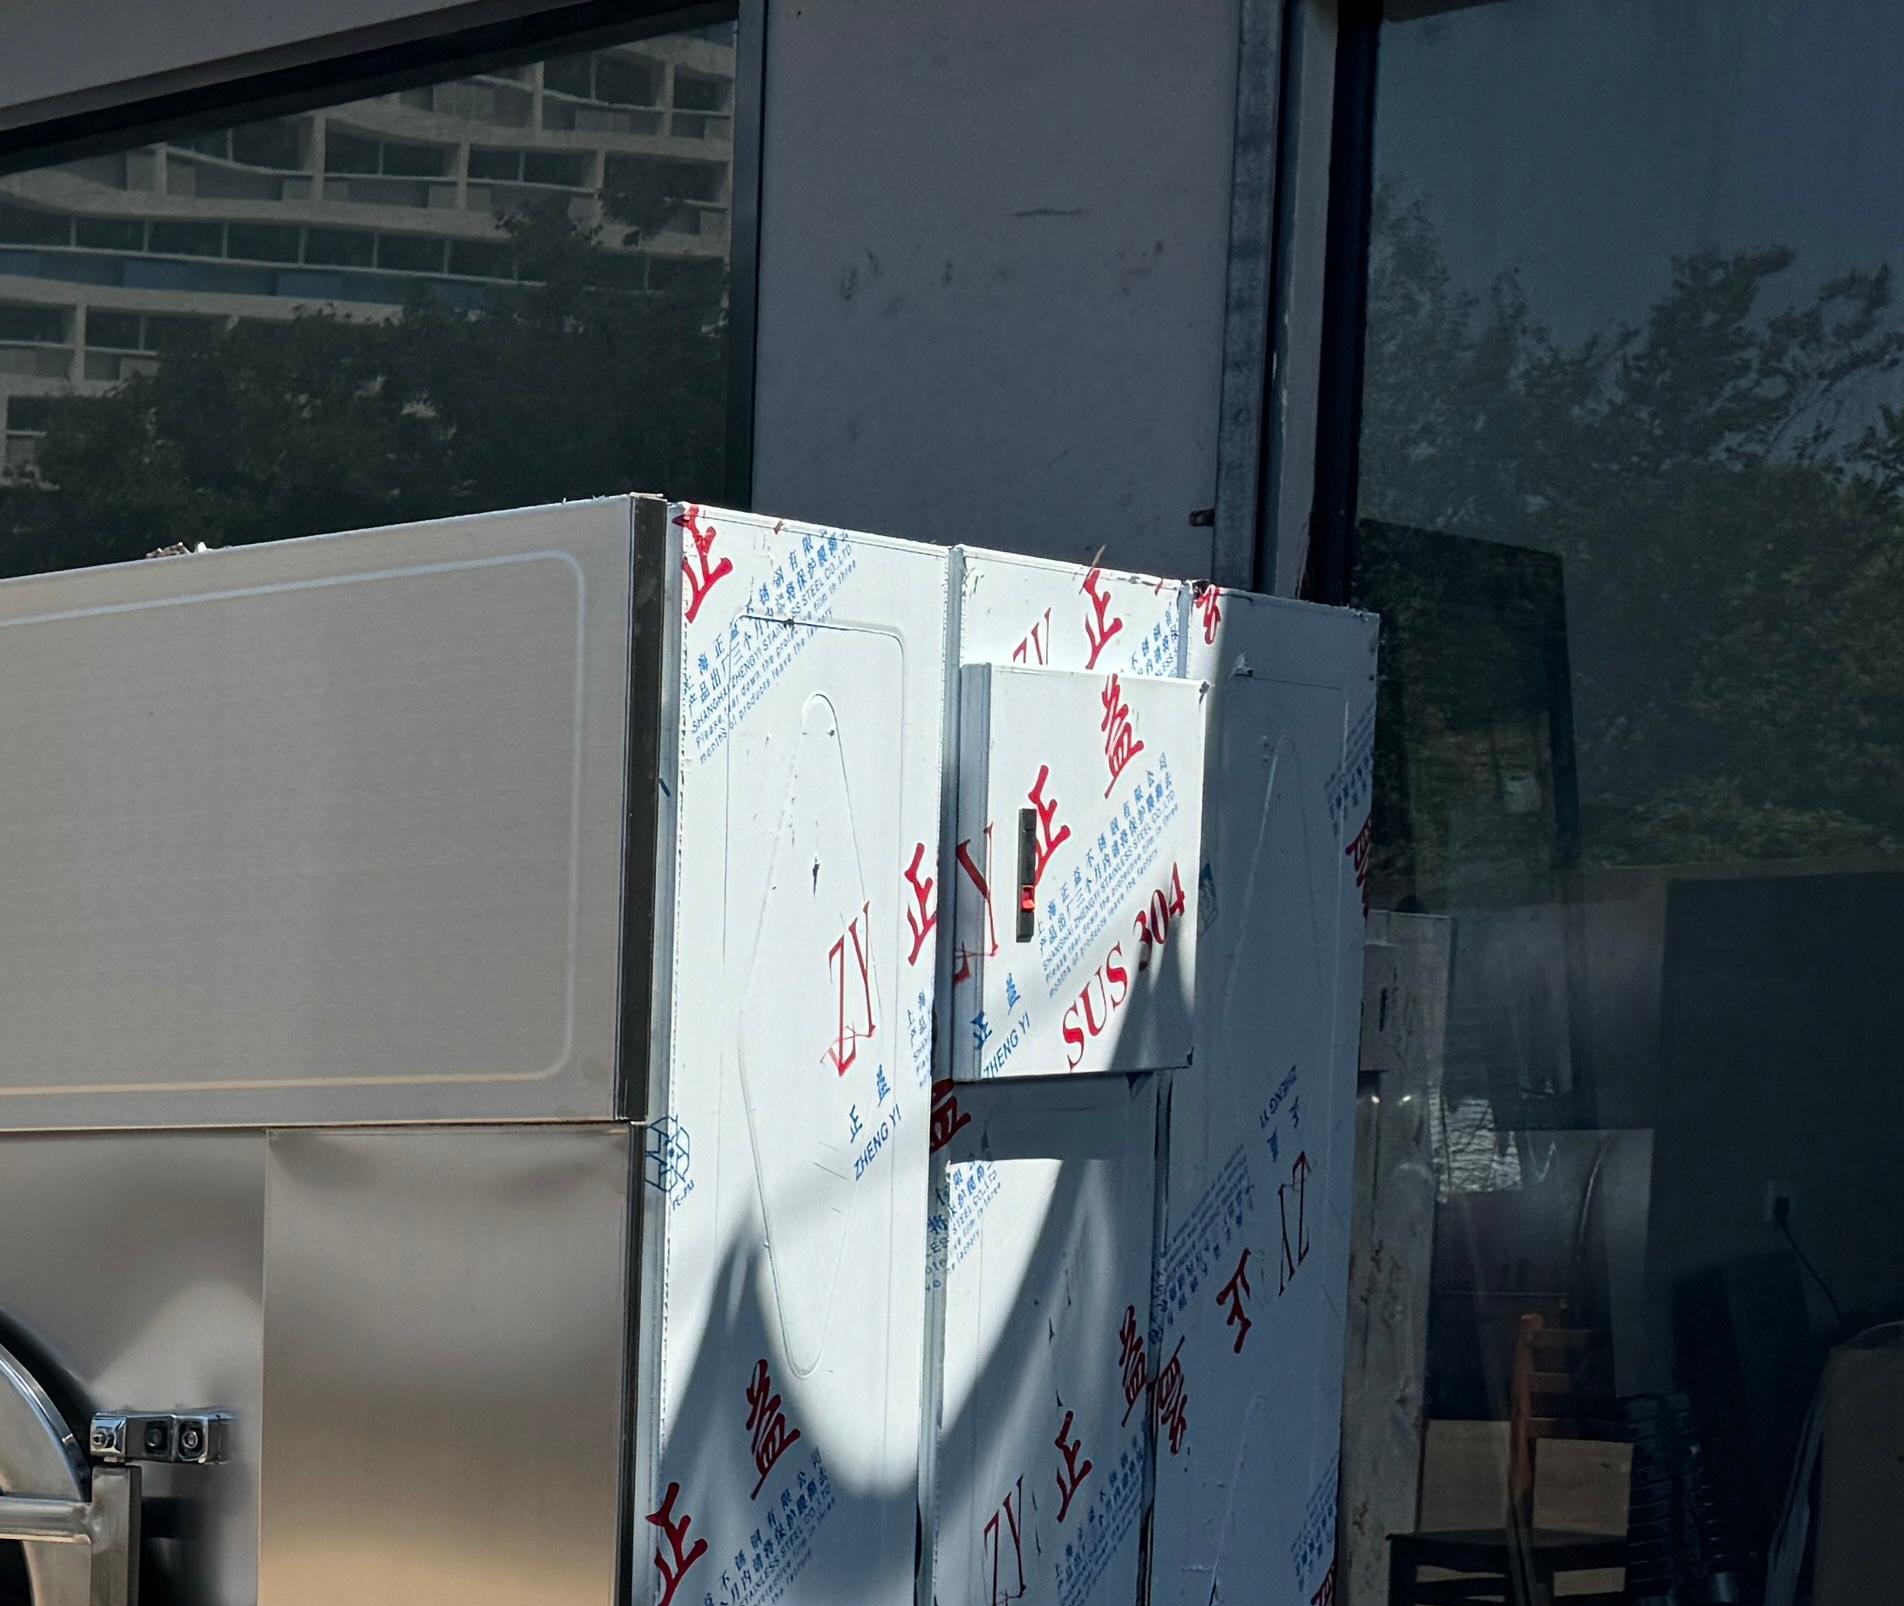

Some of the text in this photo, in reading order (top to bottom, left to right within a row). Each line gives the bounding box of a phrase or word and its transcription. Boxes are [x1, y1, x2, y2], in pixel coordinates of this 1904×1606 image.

[1062, 863, 1187, 1071] SUS 304
[1019, 1011, 1032, 1037] YI
[854, 1102, 903, 1181] ZHENG YI
